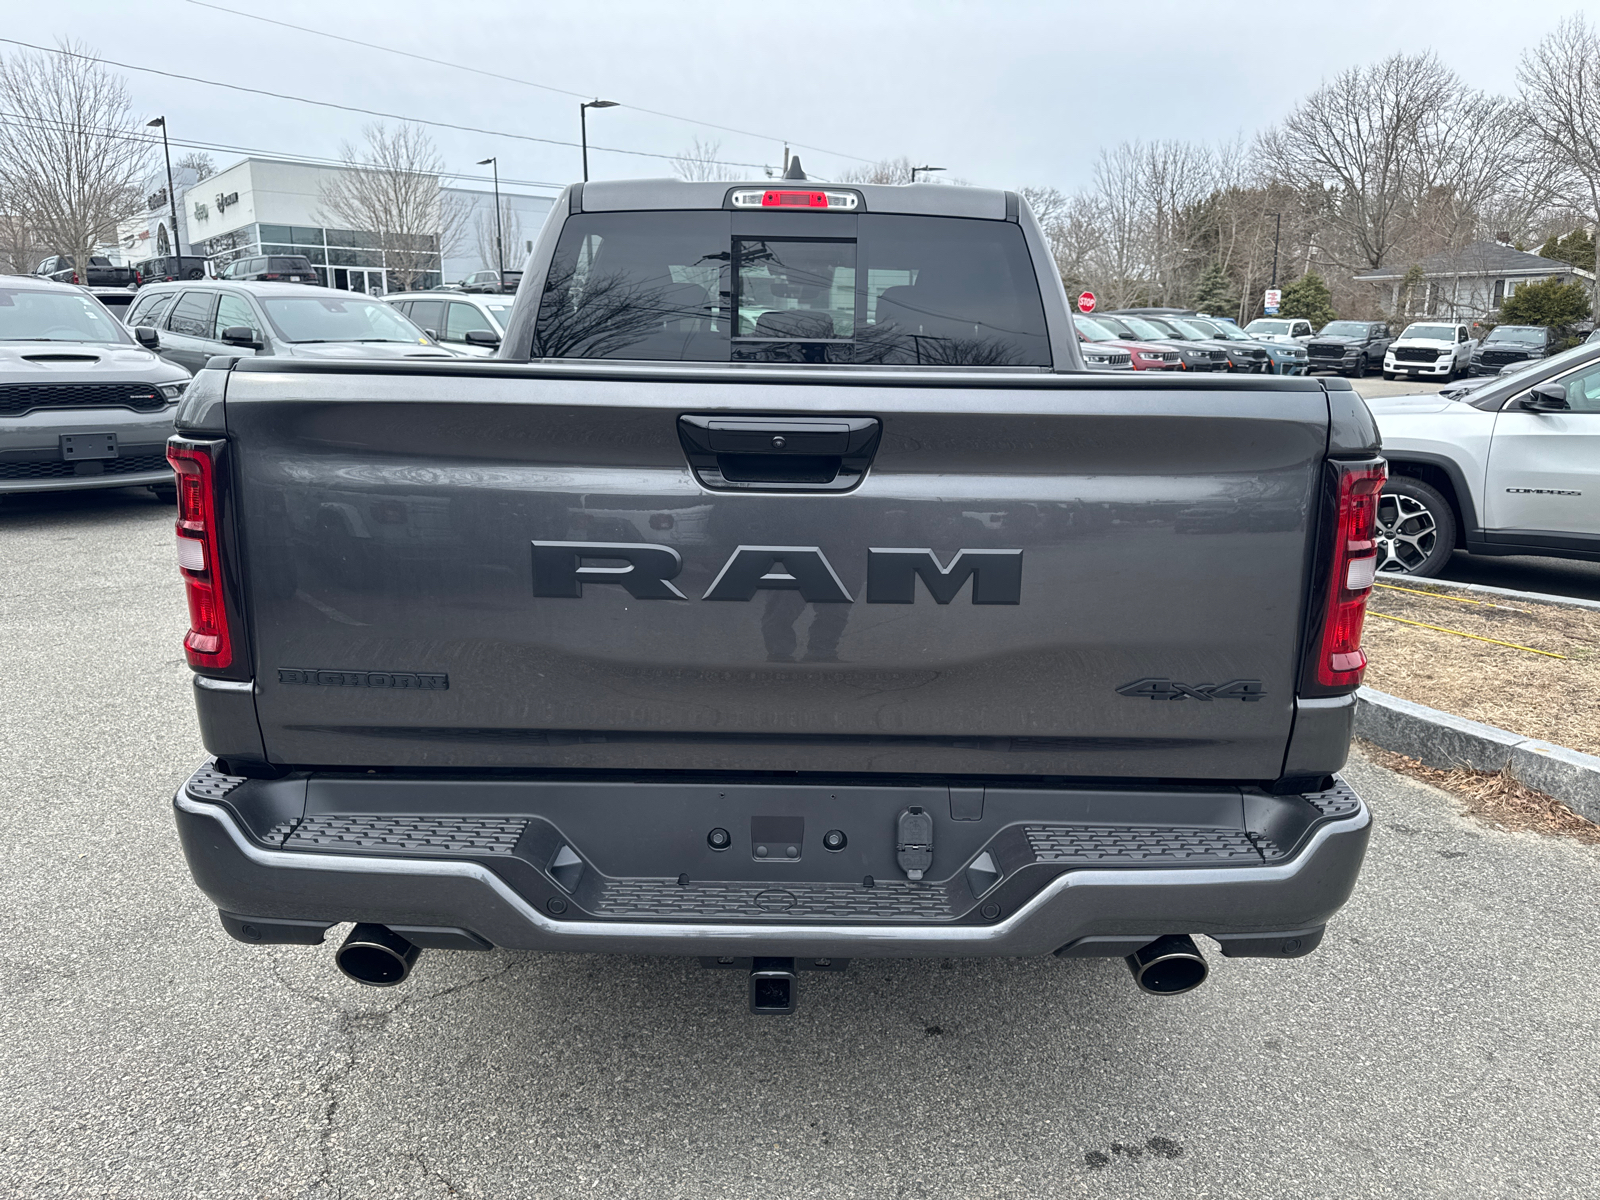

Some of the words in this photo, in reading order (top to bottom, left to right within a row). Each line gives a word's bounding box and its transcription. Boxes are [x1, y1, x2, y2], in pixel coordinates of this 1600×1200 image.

[1079, 297, 1095, 307] STOP
[1505, 487, 1582, 496] COMPASS
[531, 540, 1023, 605] RAM
[1115, 678, 1267, 702] 4x4
